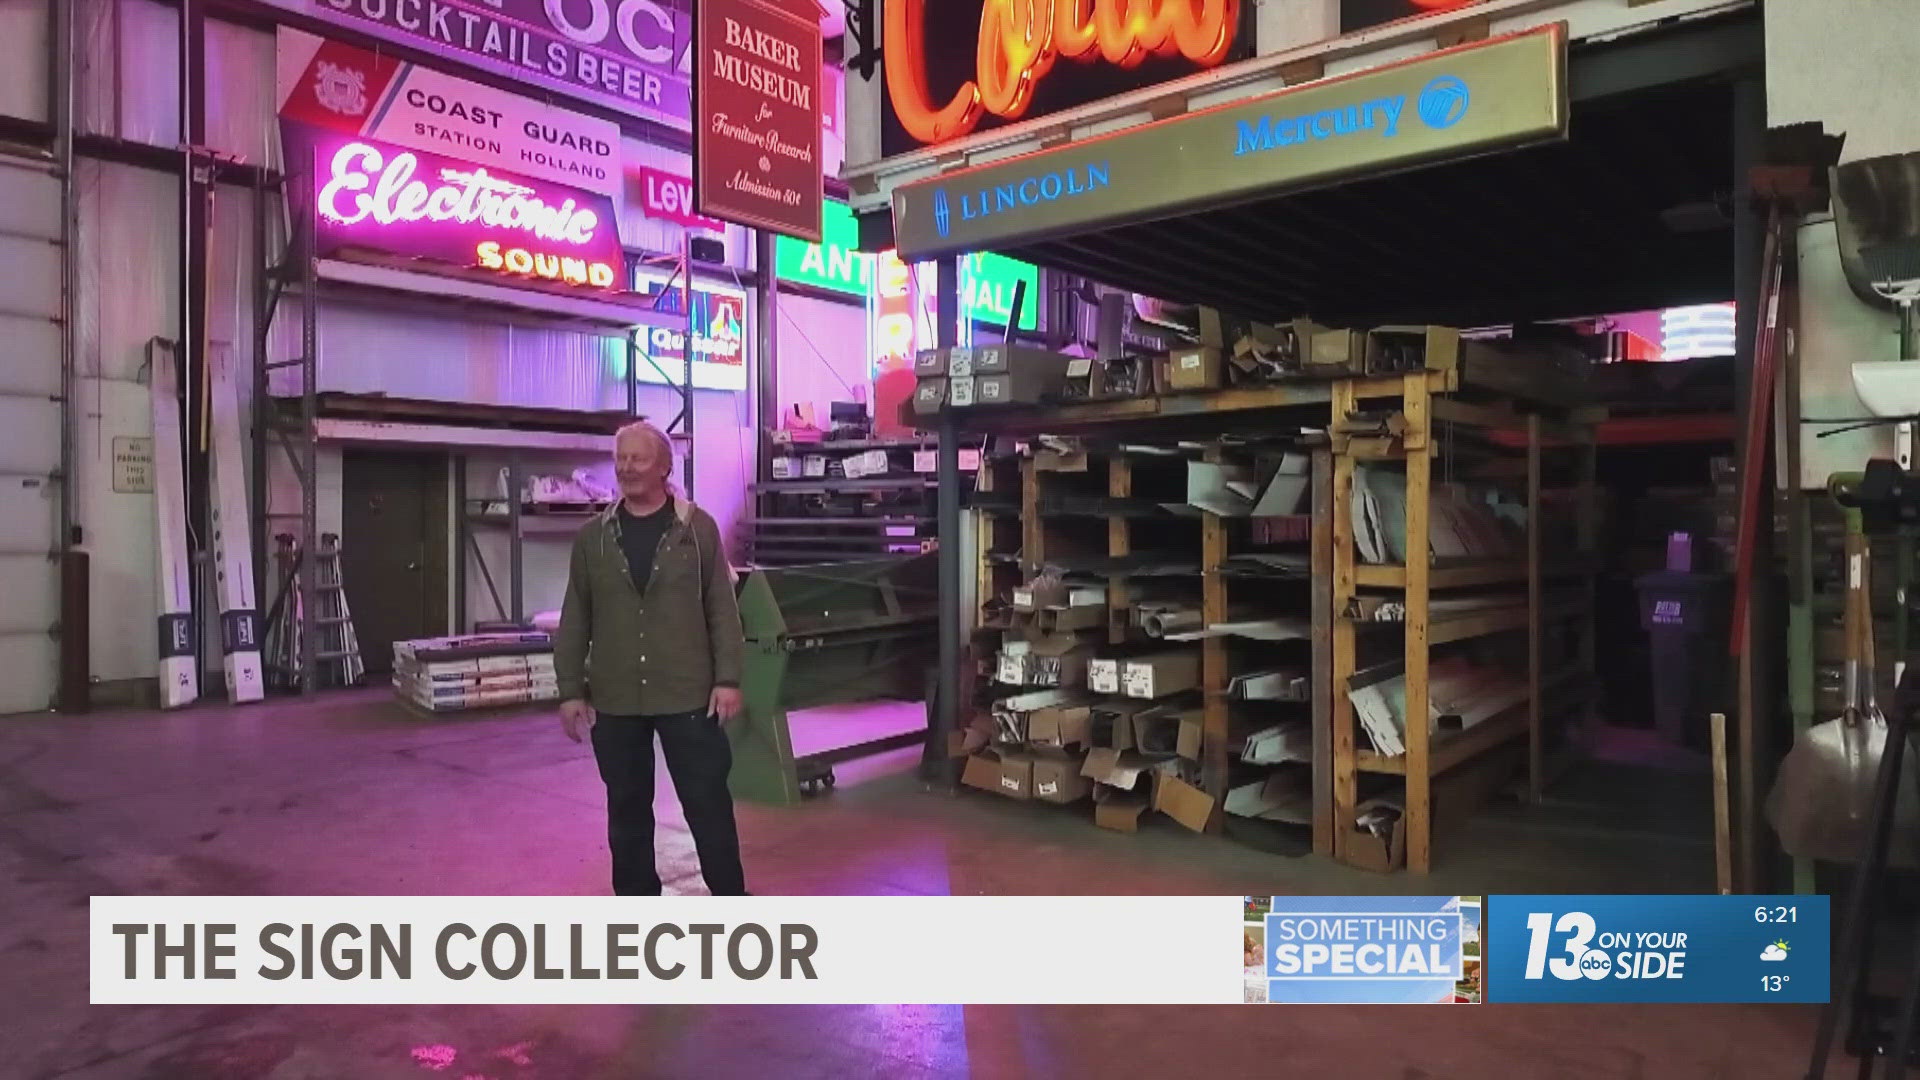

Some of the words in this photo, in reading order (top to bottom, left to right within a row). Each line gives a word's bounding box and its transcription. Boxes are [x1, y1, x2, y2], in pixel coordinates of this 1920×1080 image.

[725, 17, 801, 72] BAKER
[578, 51, 663, 106] BEER
[713, 49, 811, 111] MUSEUM
[406, 88, 504, 130] COAST
[523, 120, 612, 158] GUARD
[711, 112, 765, 149] Furniture
[764, 129, 812, 163] Research
[754, 102, 773, 122] for
[1234, 94, 1407, 157] Mercury
[414, 121, 502, 156] STATION
[520, 148, 607, 181] HOLLAND
[317, 143, 599, 247] Electronic
[725, 169, 782, 203] Admission
[960, 161, 1112, 221] LINCOLN
[477, 241, 615, 289] SOUND
[116, 453, 152, 464] PARKING
